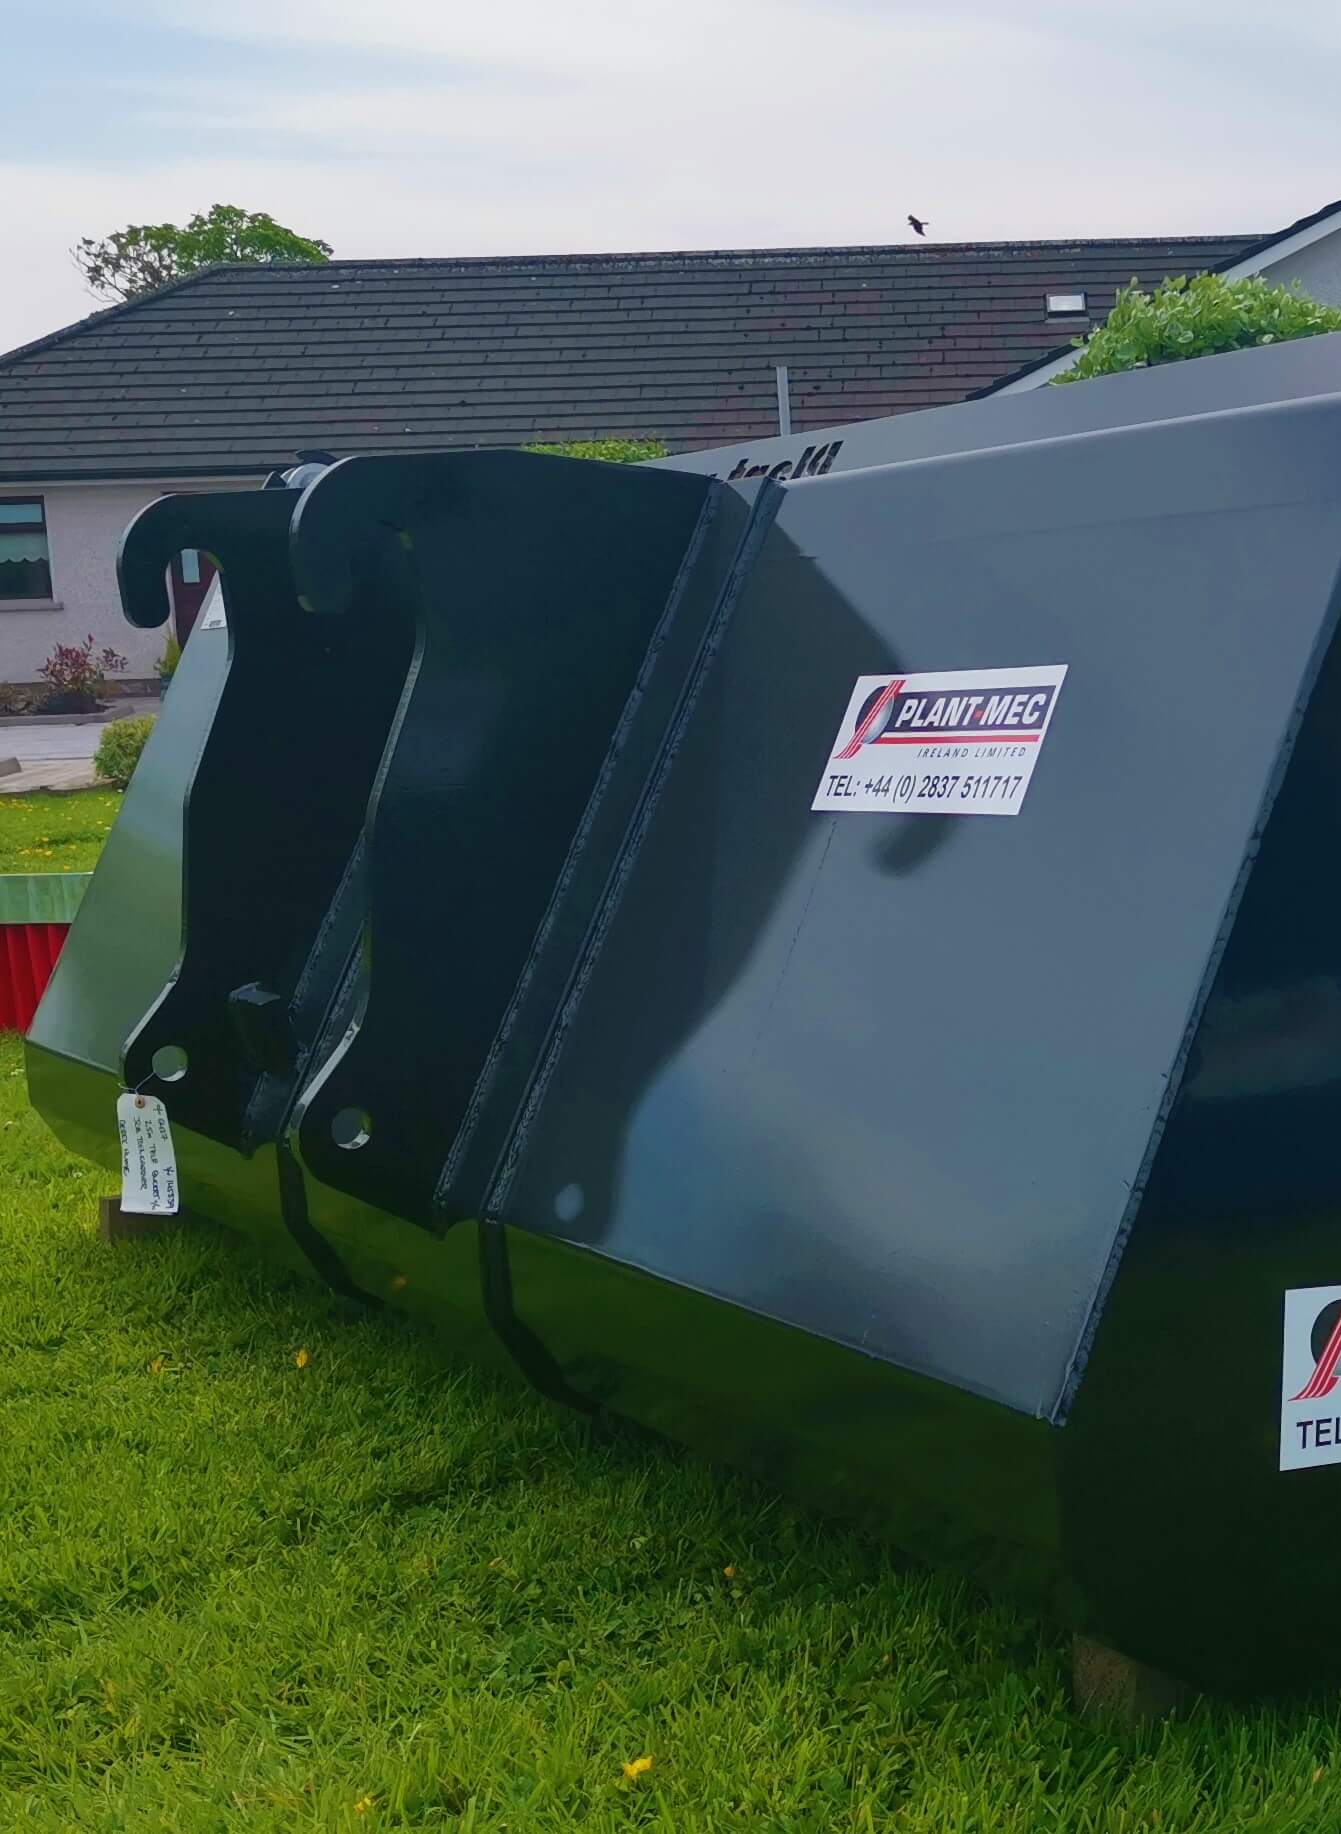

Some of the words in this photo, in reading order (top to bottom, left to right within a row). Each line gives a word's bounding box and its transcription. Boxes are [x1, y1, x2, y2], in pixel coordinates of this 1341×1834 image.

[917, 747, 969, 758] IRELAND
[975, 746, 1026, 758] LIMITED
[826, 775, 860, 797] TEL:
[864, 776, 892, 795] +44
[893, 774, 916, 804] (0)
[917, 776, 960, 798] 2837
[961, 776, 1023, 799] 511717
